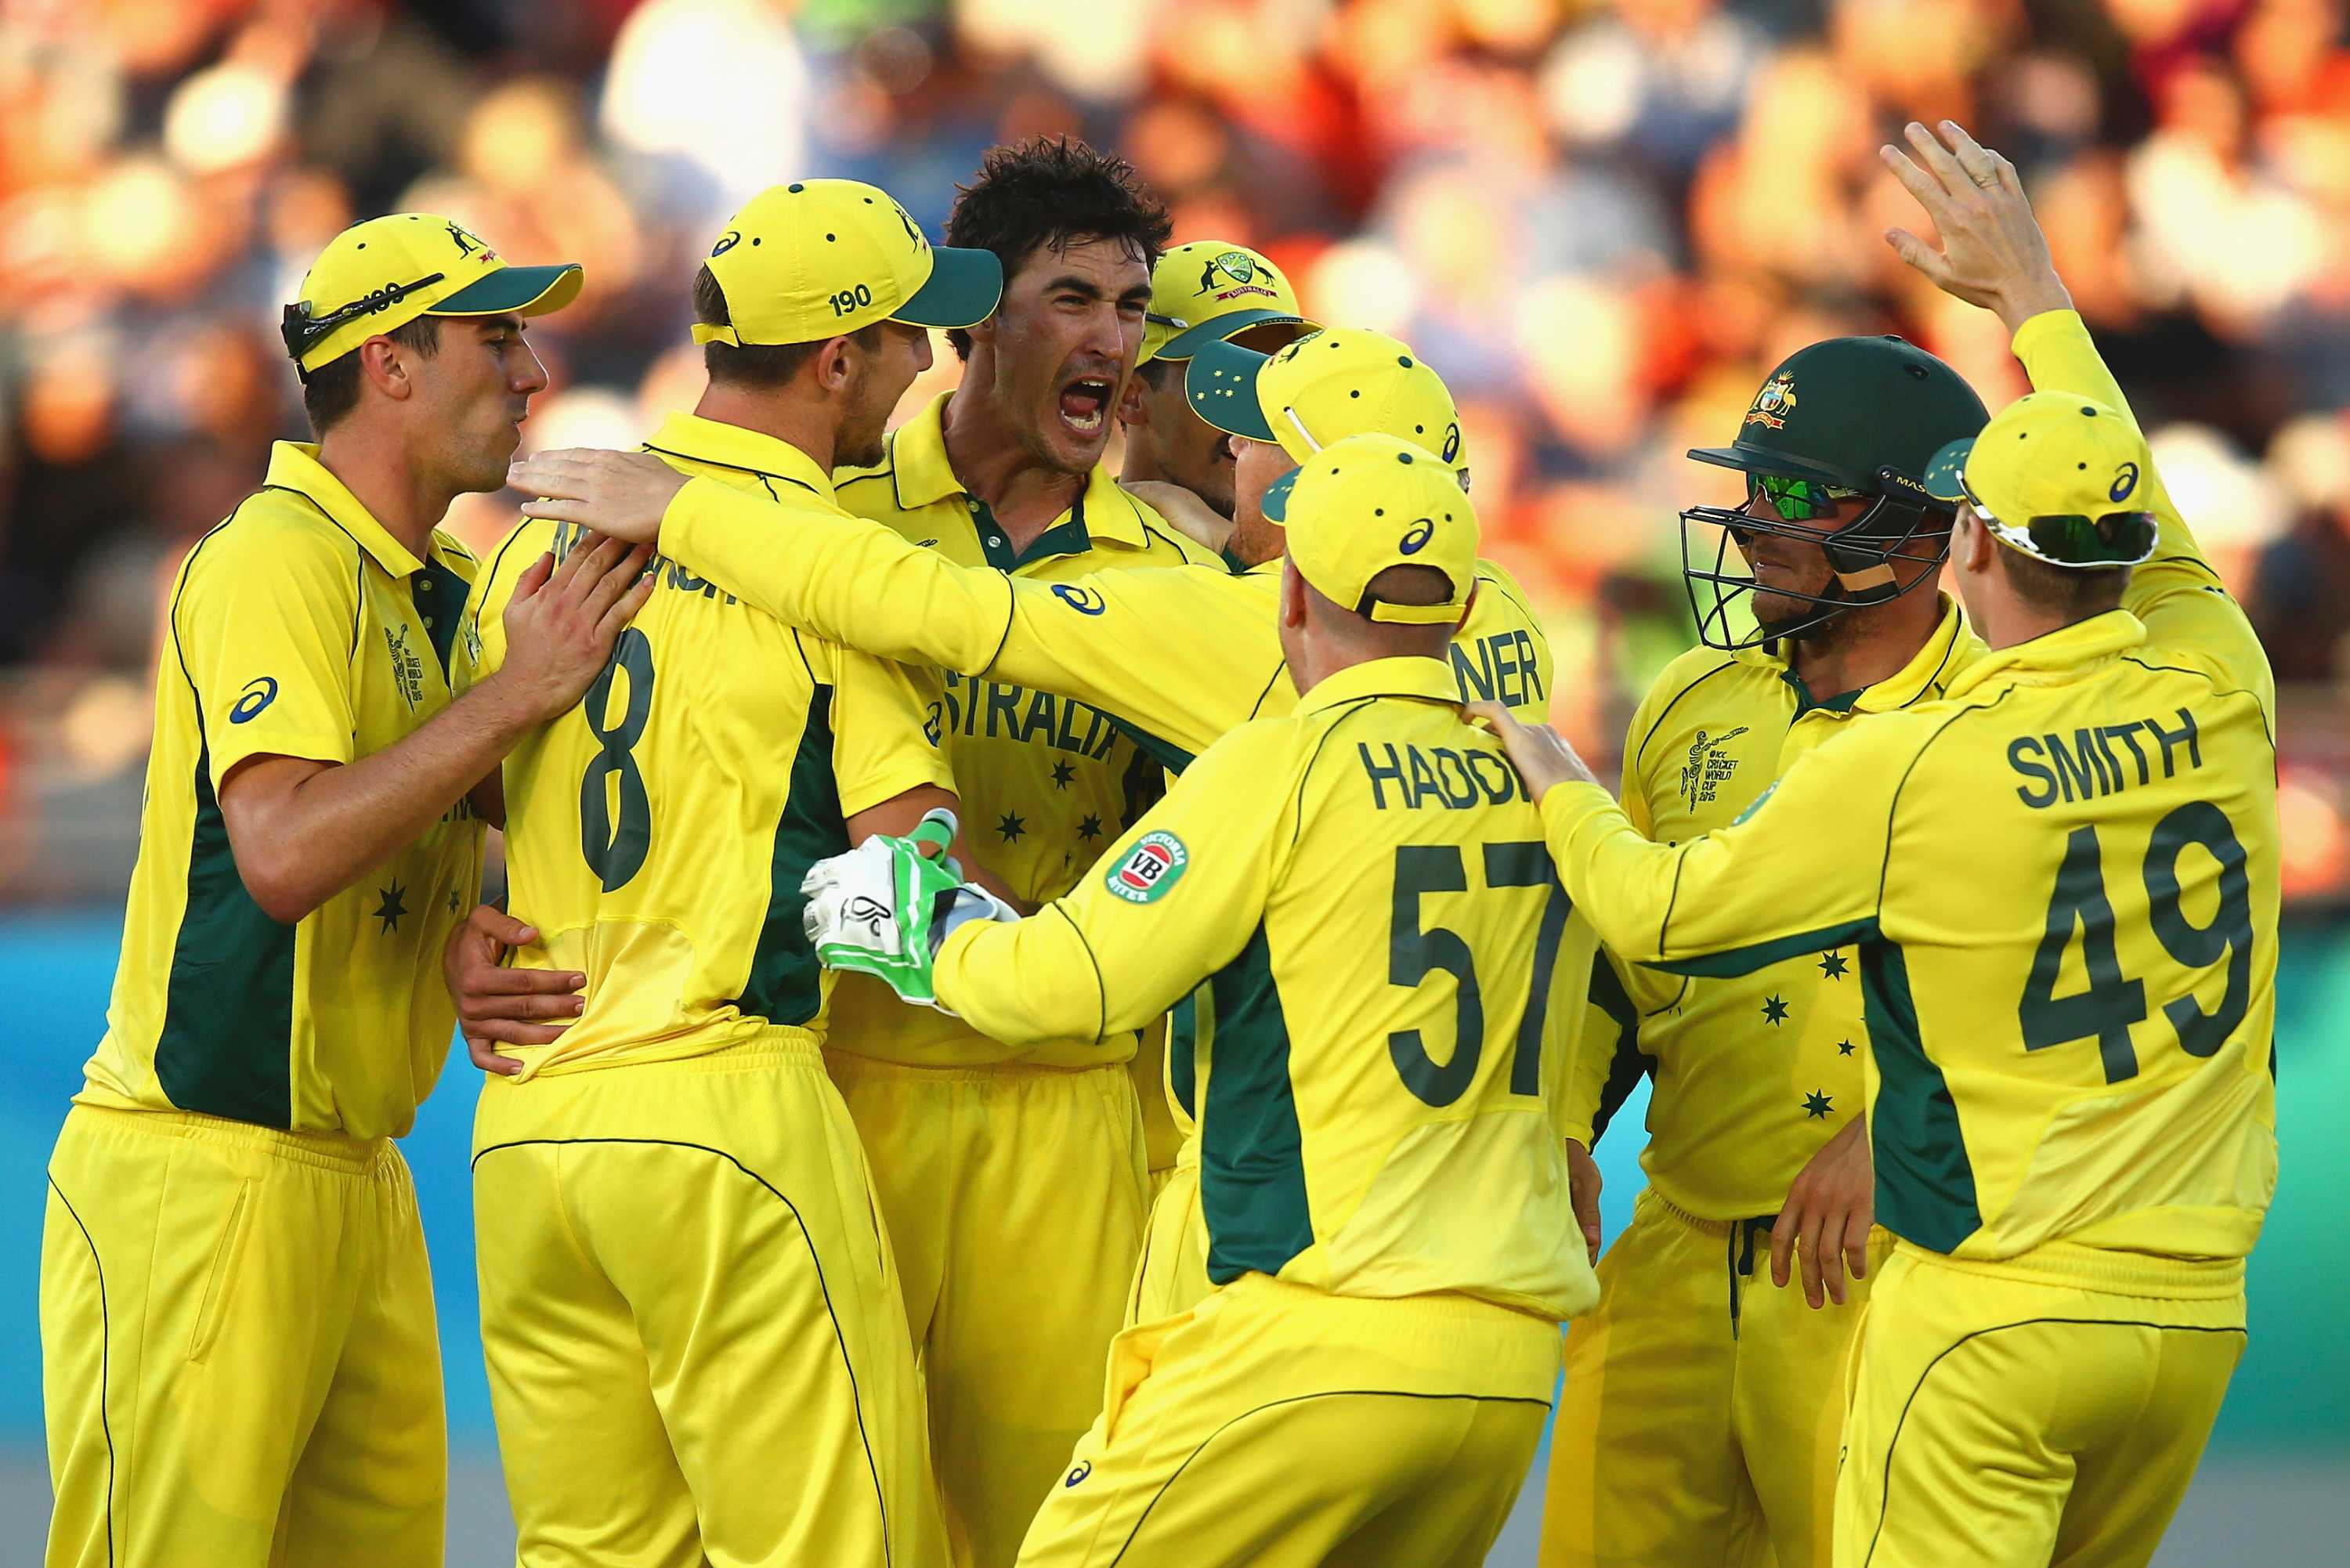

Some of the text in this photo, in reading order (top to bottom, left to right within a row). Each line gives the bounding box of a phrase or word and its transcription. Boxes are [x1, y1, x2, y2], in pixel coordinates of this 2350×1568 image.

[829, 284, 872, 317] 190
[1896, 476, 1925, 493] MAS
[1450, 629, 1544, 708] NER
[943, 668, 1119, 766] STRALIA
[580, 627, 656, 894] 8
[1358, 742, 1532, 810] HADDI
[1701, 781, 1717, 791] CUP
[1705, 770, 1732, 781] WORLD
[1706, 759, 1739, 770] CRICKET
[2007, 708, 2202, 808] SMITH
[1130, 852, 1163, 880] VB
[1387, 841, 1572, 1108] 57
[2019, 800, 2254, 1085] 49
